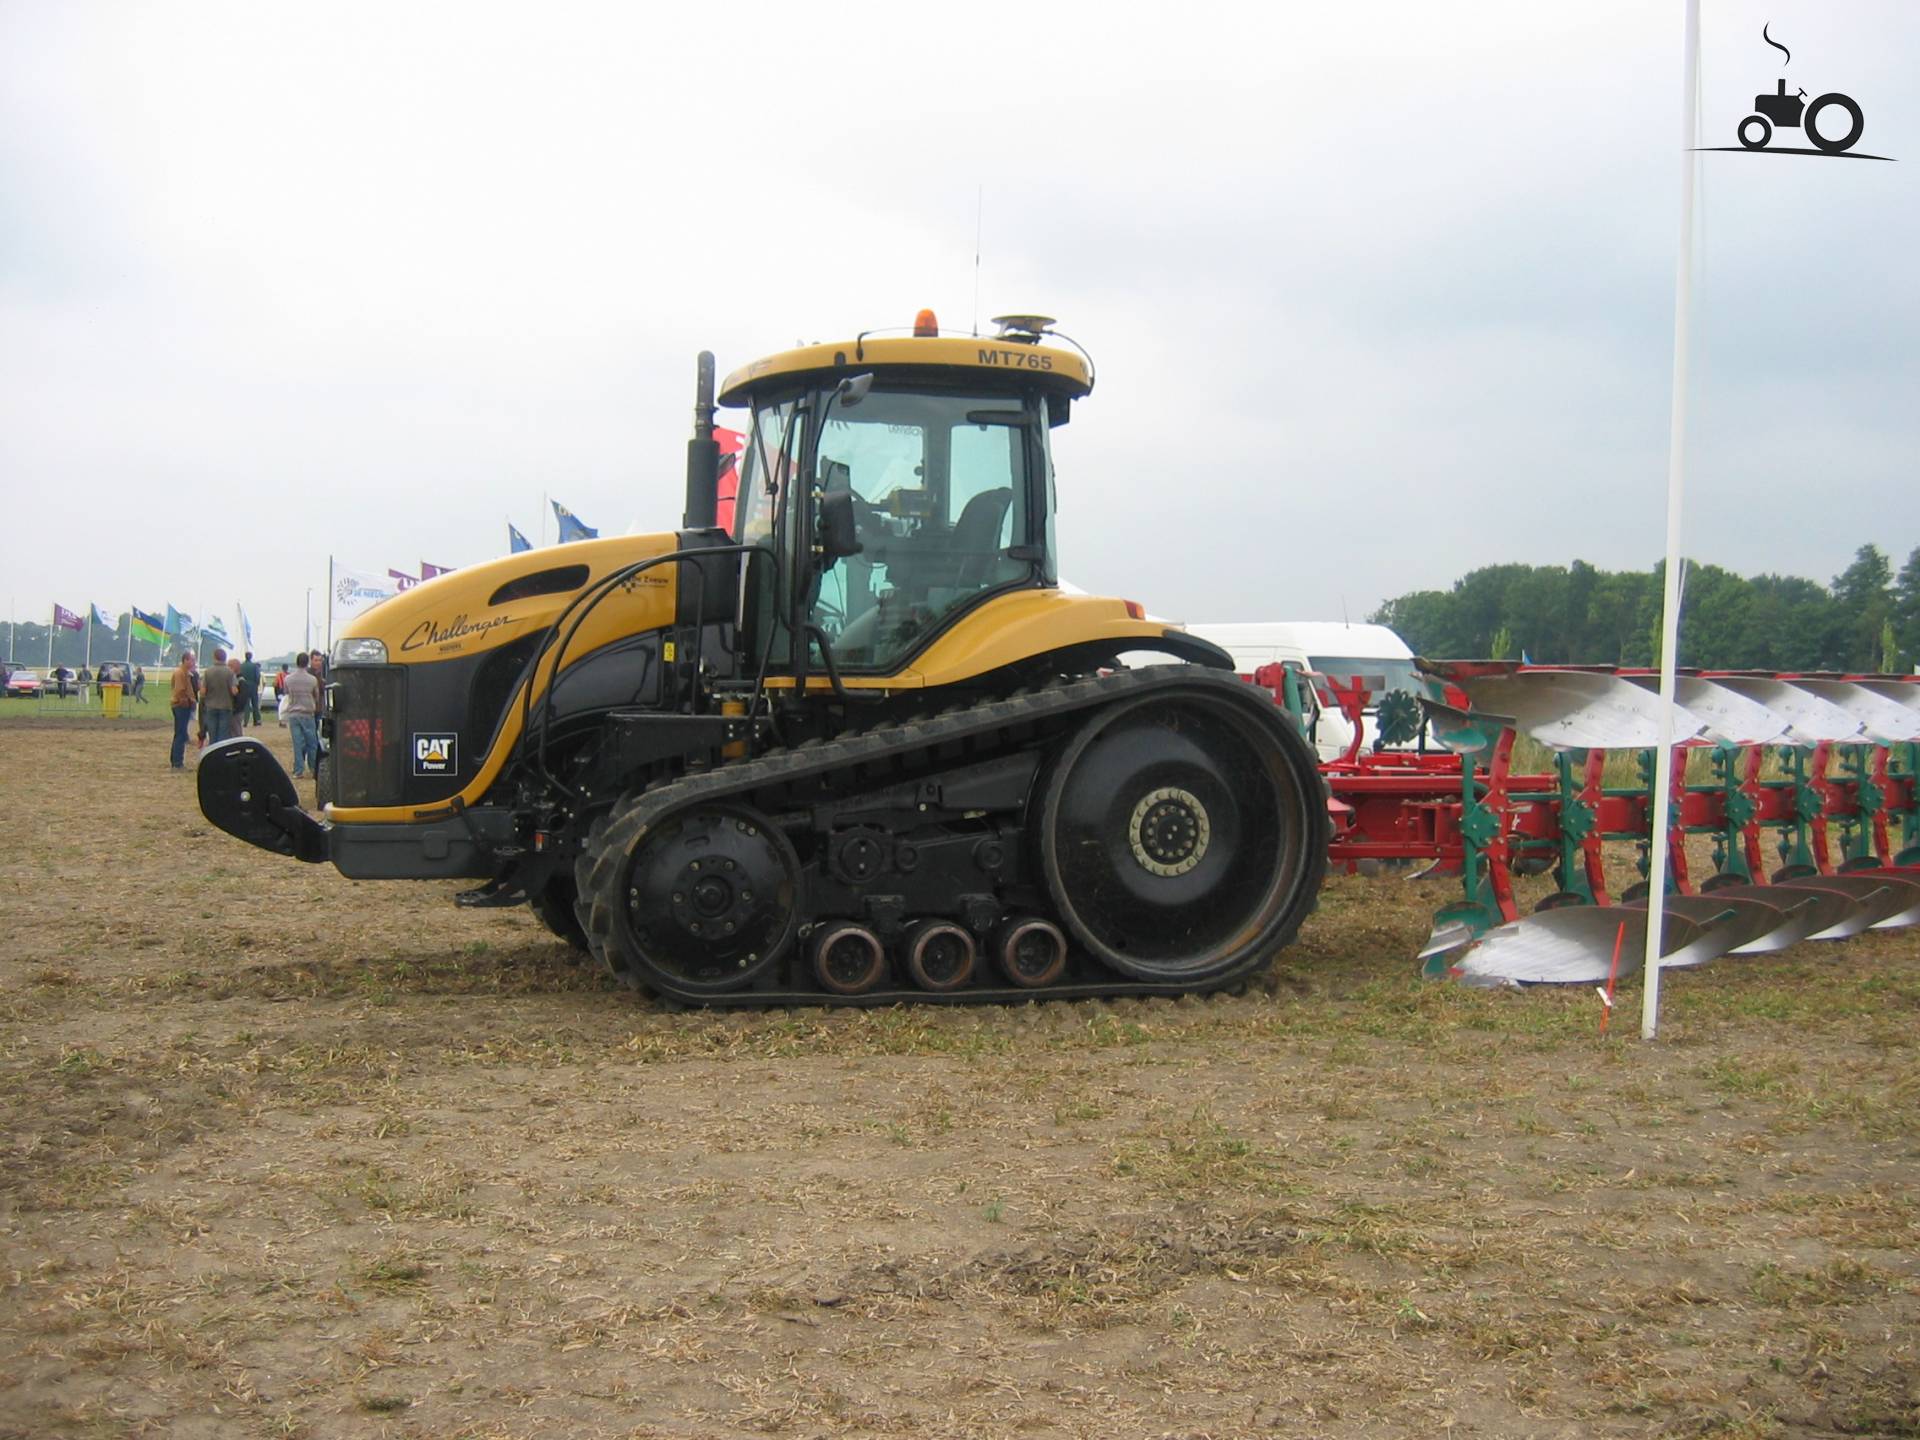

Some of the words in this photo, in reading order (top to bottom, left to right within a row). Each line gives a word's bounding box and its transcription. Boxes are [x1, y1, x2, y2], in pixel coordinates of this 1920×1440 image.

[978, 349, 1052, 370] MT765
[400, 614, 516, 651] Challenger
[417, 738, 452, 760] CAT
[423, 761, 446, 770] Power
